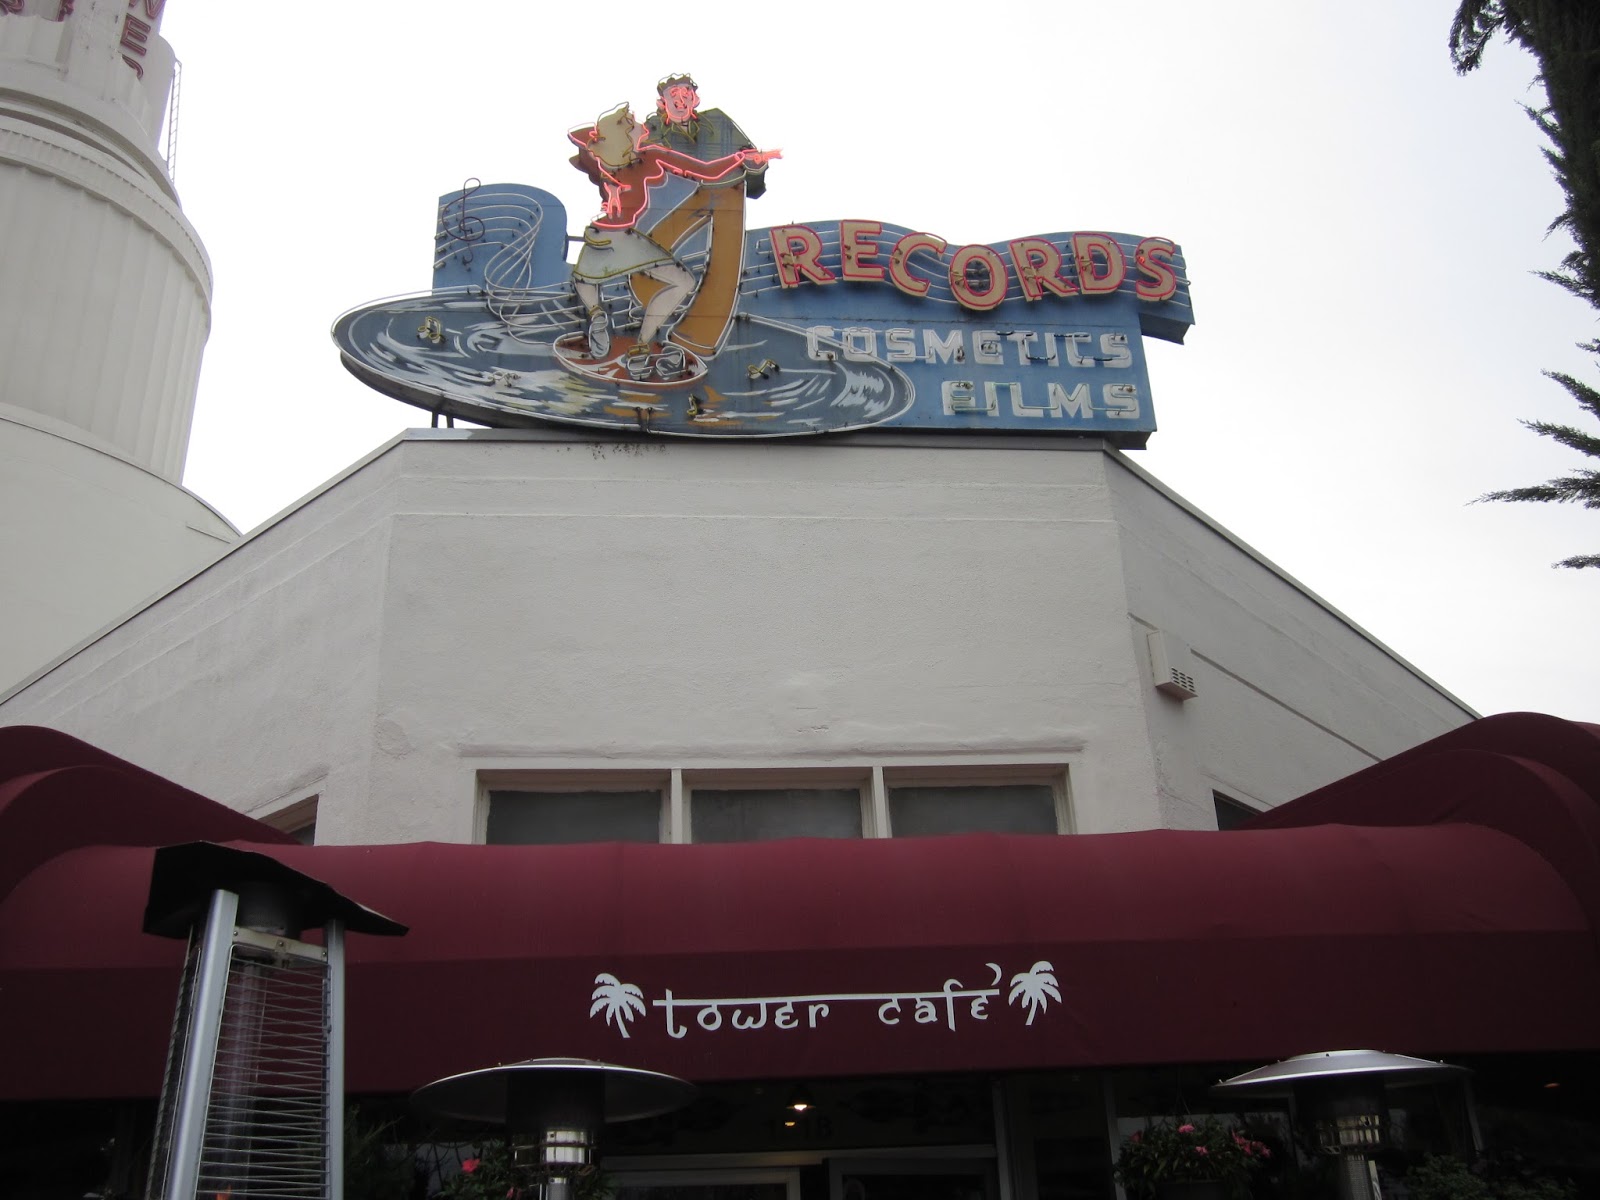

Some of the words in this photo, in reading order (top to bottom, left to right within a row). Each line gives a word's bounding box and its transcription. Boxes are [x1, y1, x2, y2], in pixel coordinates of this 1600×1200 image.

[769, 219, 1178, 311] RECORDS
[806, 327, 1133, 368] COSMETICS
[942, 381, 1140, 419] FILMS
[653, 988, 829, 1038] tower
